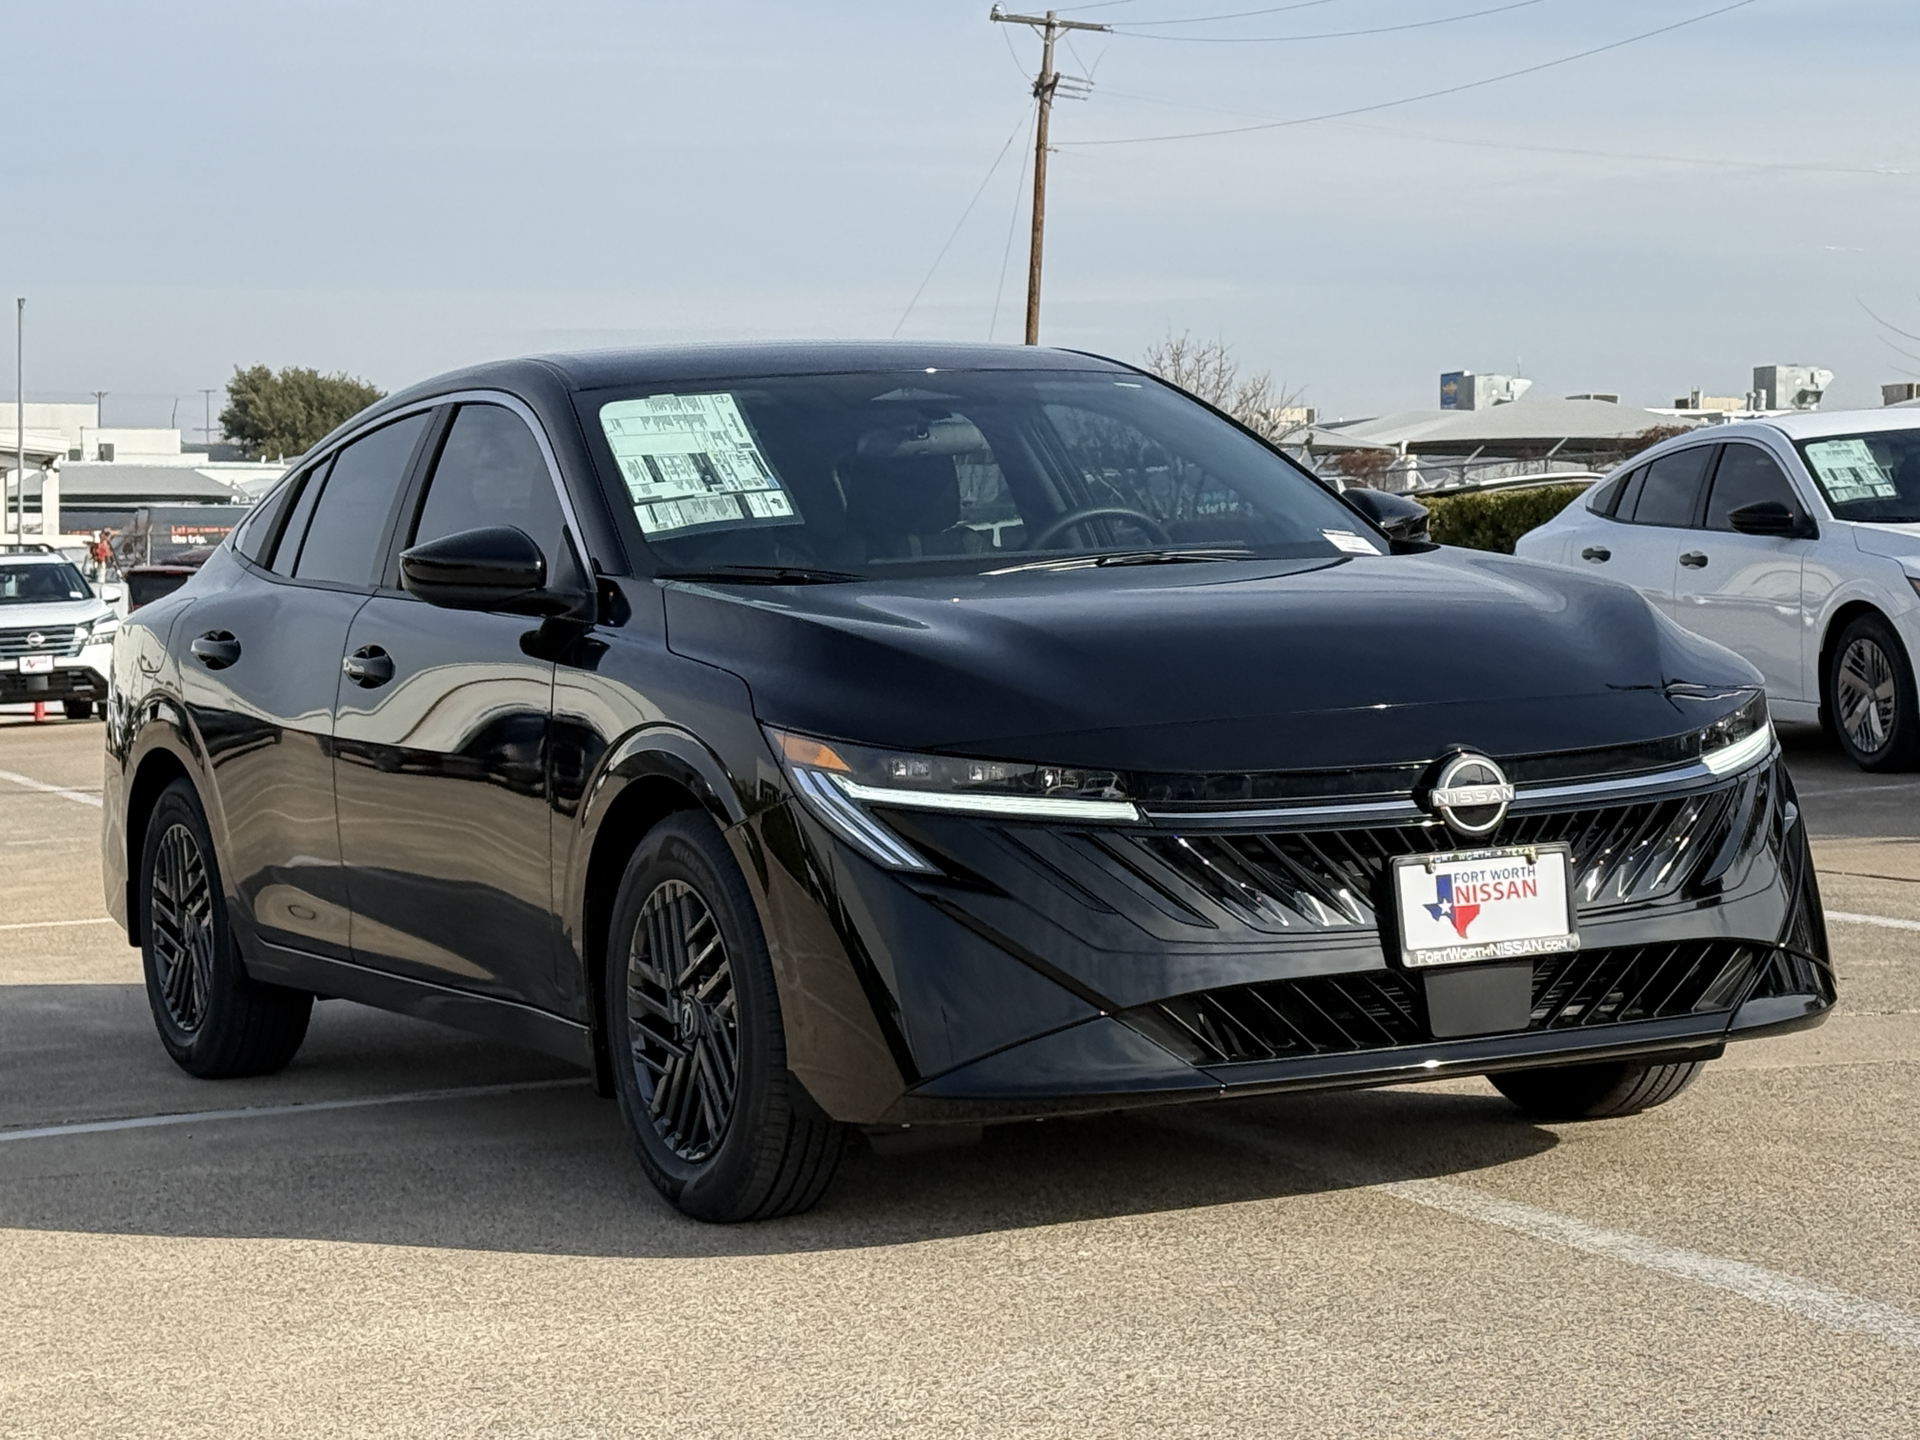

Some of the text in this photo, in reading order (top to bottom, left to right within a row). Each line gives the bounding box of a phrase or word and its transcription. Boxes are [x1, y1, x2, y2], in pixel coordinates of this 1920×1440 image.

[1434, 787, 1513, 804] NISSAN
[1458, 850, 1492, 860] WORTH
[1504, 846, 1536, 857] TEXAS
[1454, 865, 1536, 883] FORT WORTH
[1455, 879, 1537, 904] NISSAN
